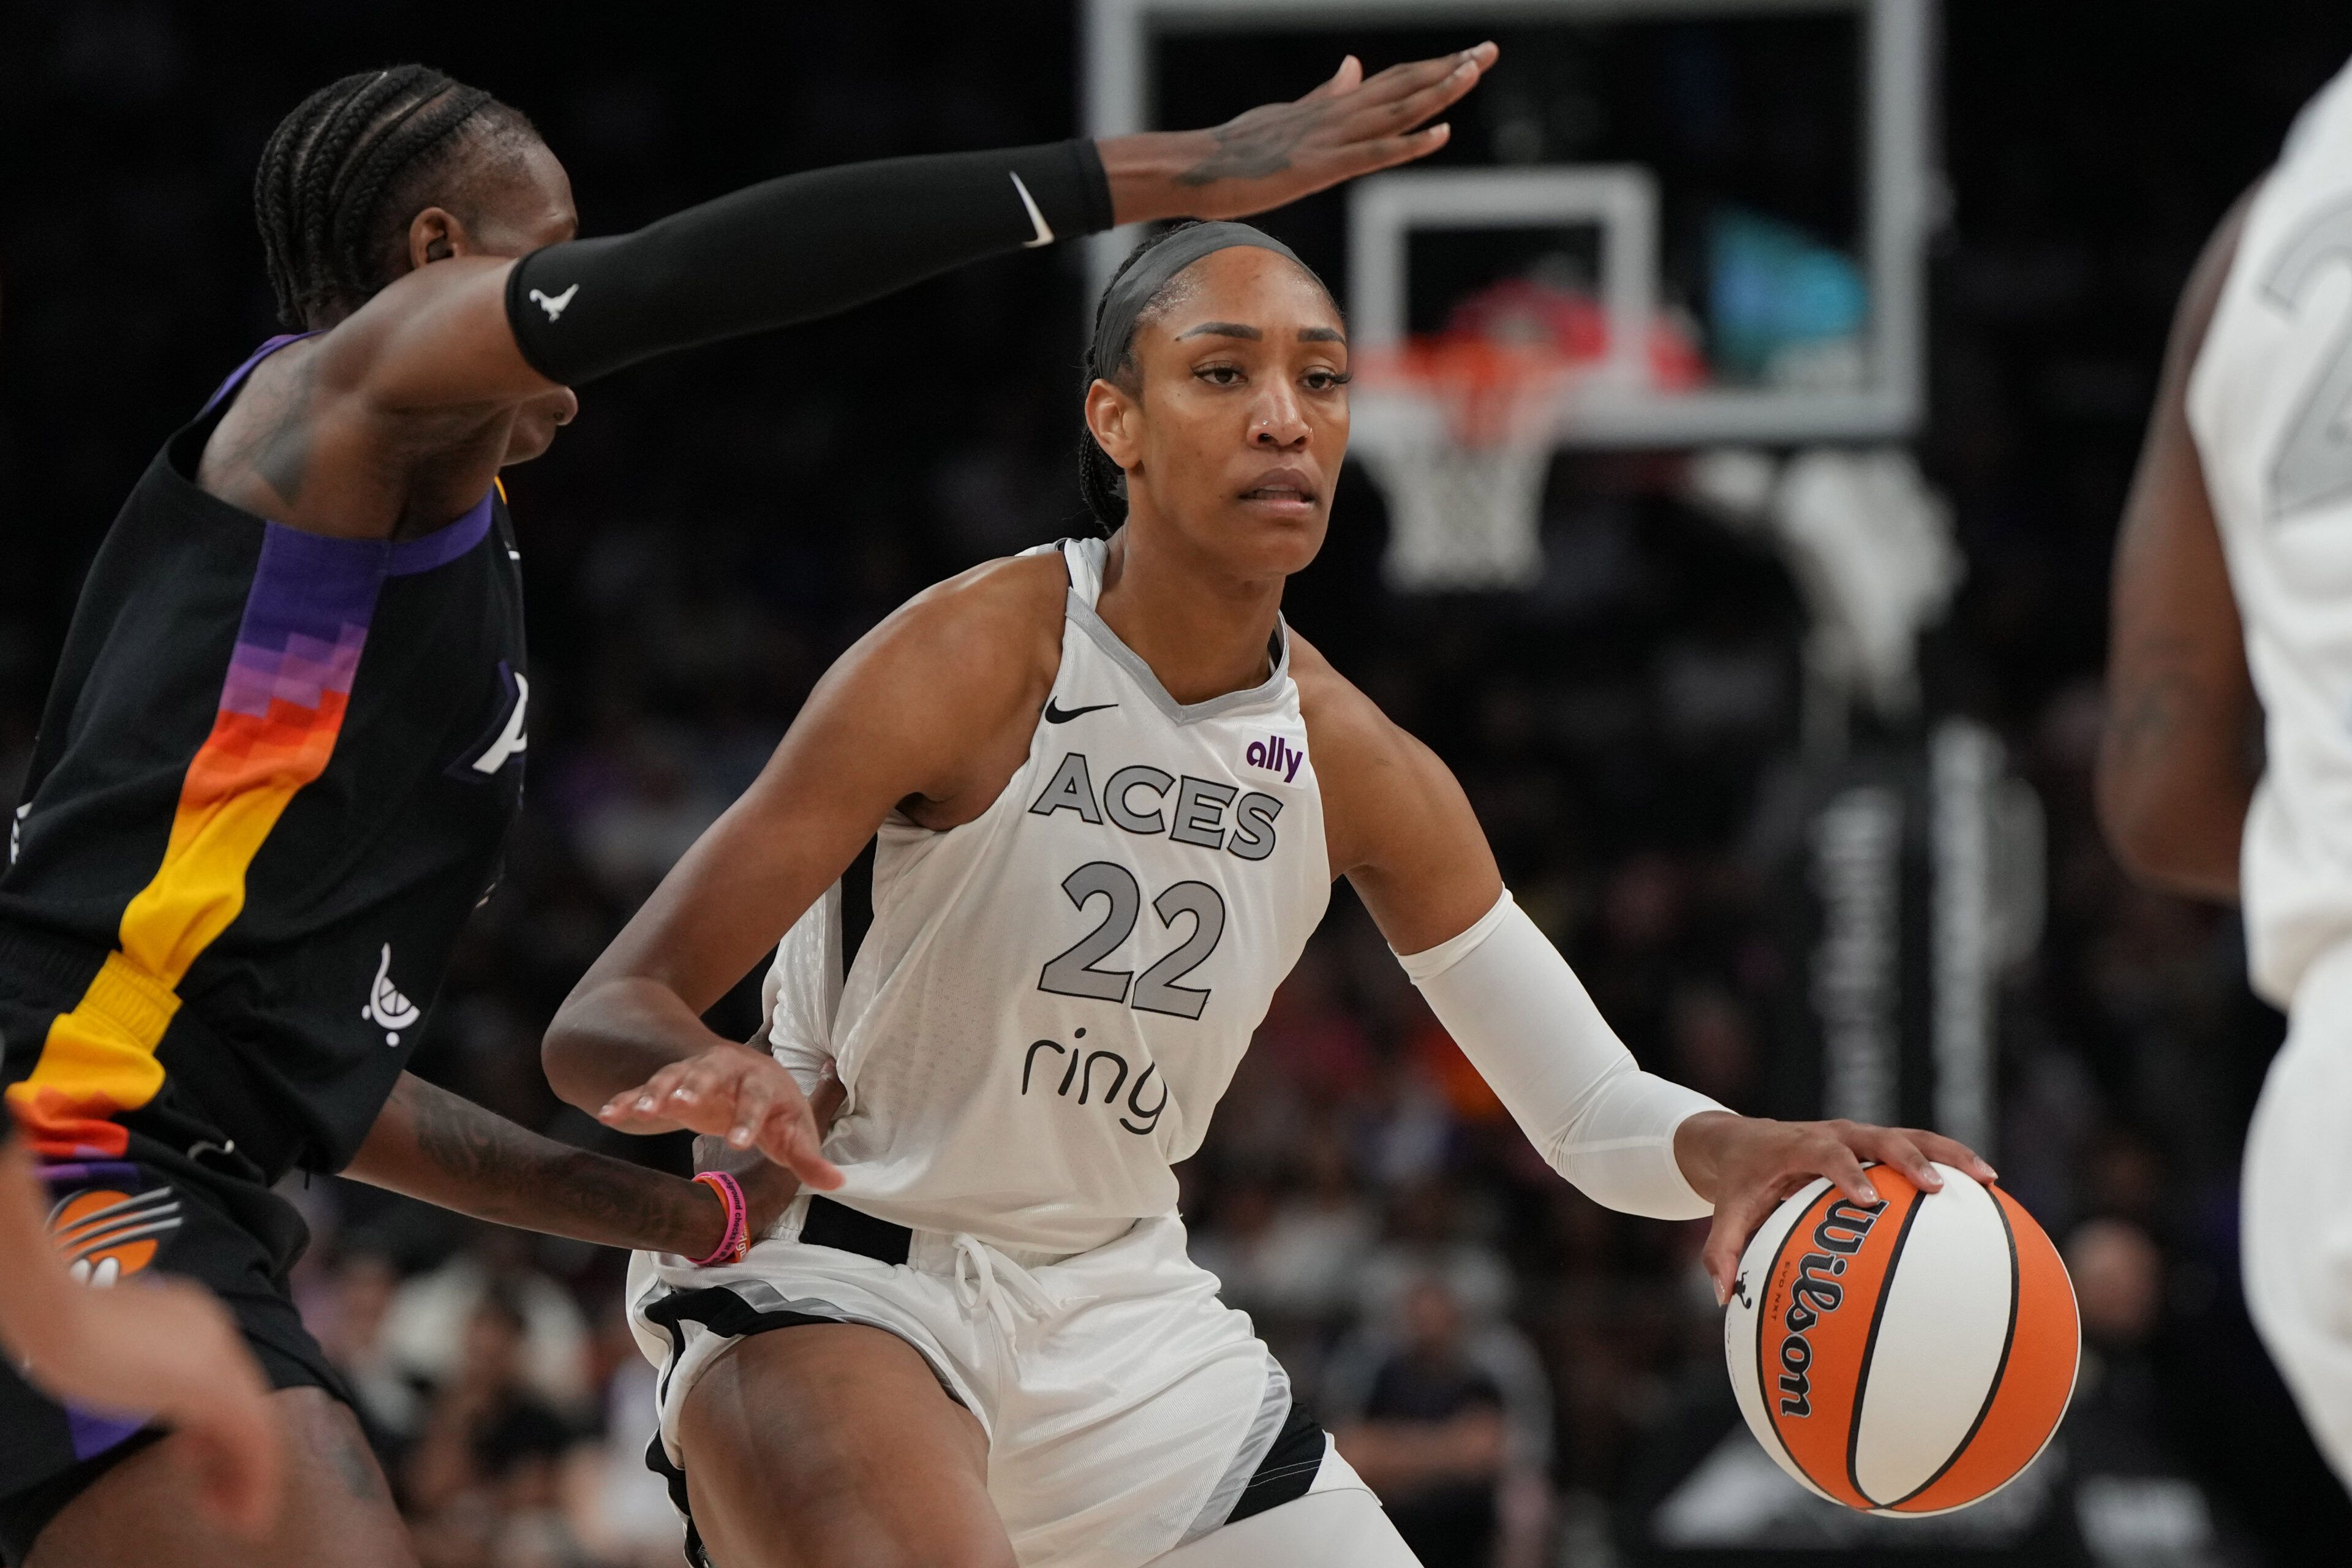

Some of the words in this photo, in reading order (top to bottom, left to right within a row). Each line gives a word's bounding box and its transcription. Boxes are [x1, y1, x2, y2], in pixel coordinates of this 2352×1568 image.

[1028, 752, 1284, 861] ACES
[1246, 735, 1303, 783] ally
[1037, 861, 1226, 1021] 22
[1021, 1028, 1167, 1136] ring
[729, 1213, 742, 1240] checks
[1778, 1197, 1890, 1419] Wilson
